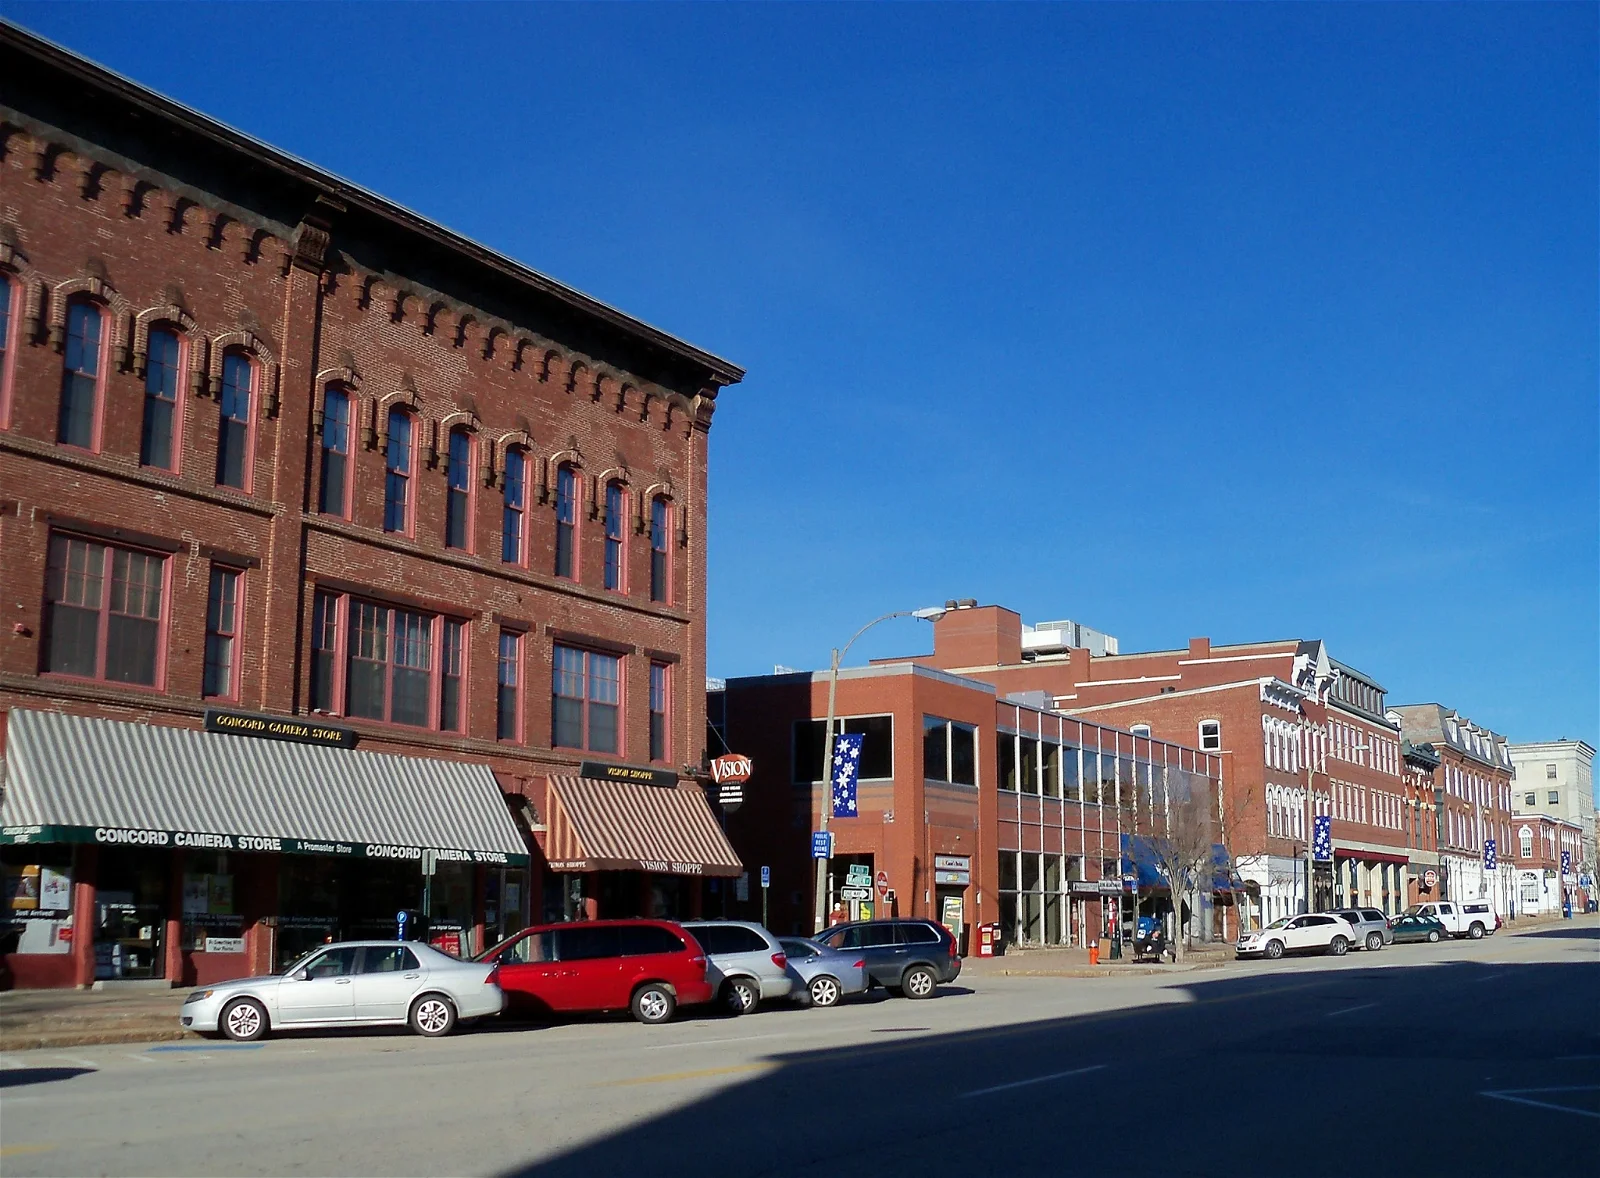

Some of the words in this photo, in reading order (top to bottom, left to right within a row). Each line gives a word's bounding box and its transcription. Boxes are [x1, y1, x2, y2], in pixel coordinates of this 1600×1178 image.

[217, 715, 265, 730] CONCORD
[269, 723, 308, 736] CAMERA
[312, 728, 342, 741] STORE
[607, 767, 629, 778] VISION
[630, 769, 653, 781] SHOPPE
[710, 759, 752, 783] VISION
[95, 828, 169, 845] CONCORD
[174, 832, 233, 849] CAMERA
[238, 836, 282, 851] STORE
[297, 841, 303, 850] A
[303, 842, 335, 854] Promaster
[336, 843, 352, 854] Store
[366, 844, 421, 860] CONCORD
[433, 849, 472, 861] AMERA
[474, 851, 508, 863] STORE
[566, 861, 587, 869] SHOPPE
[639, 860, 669, 873] VISION
[672, 861, 703, 874] SHOPPE
